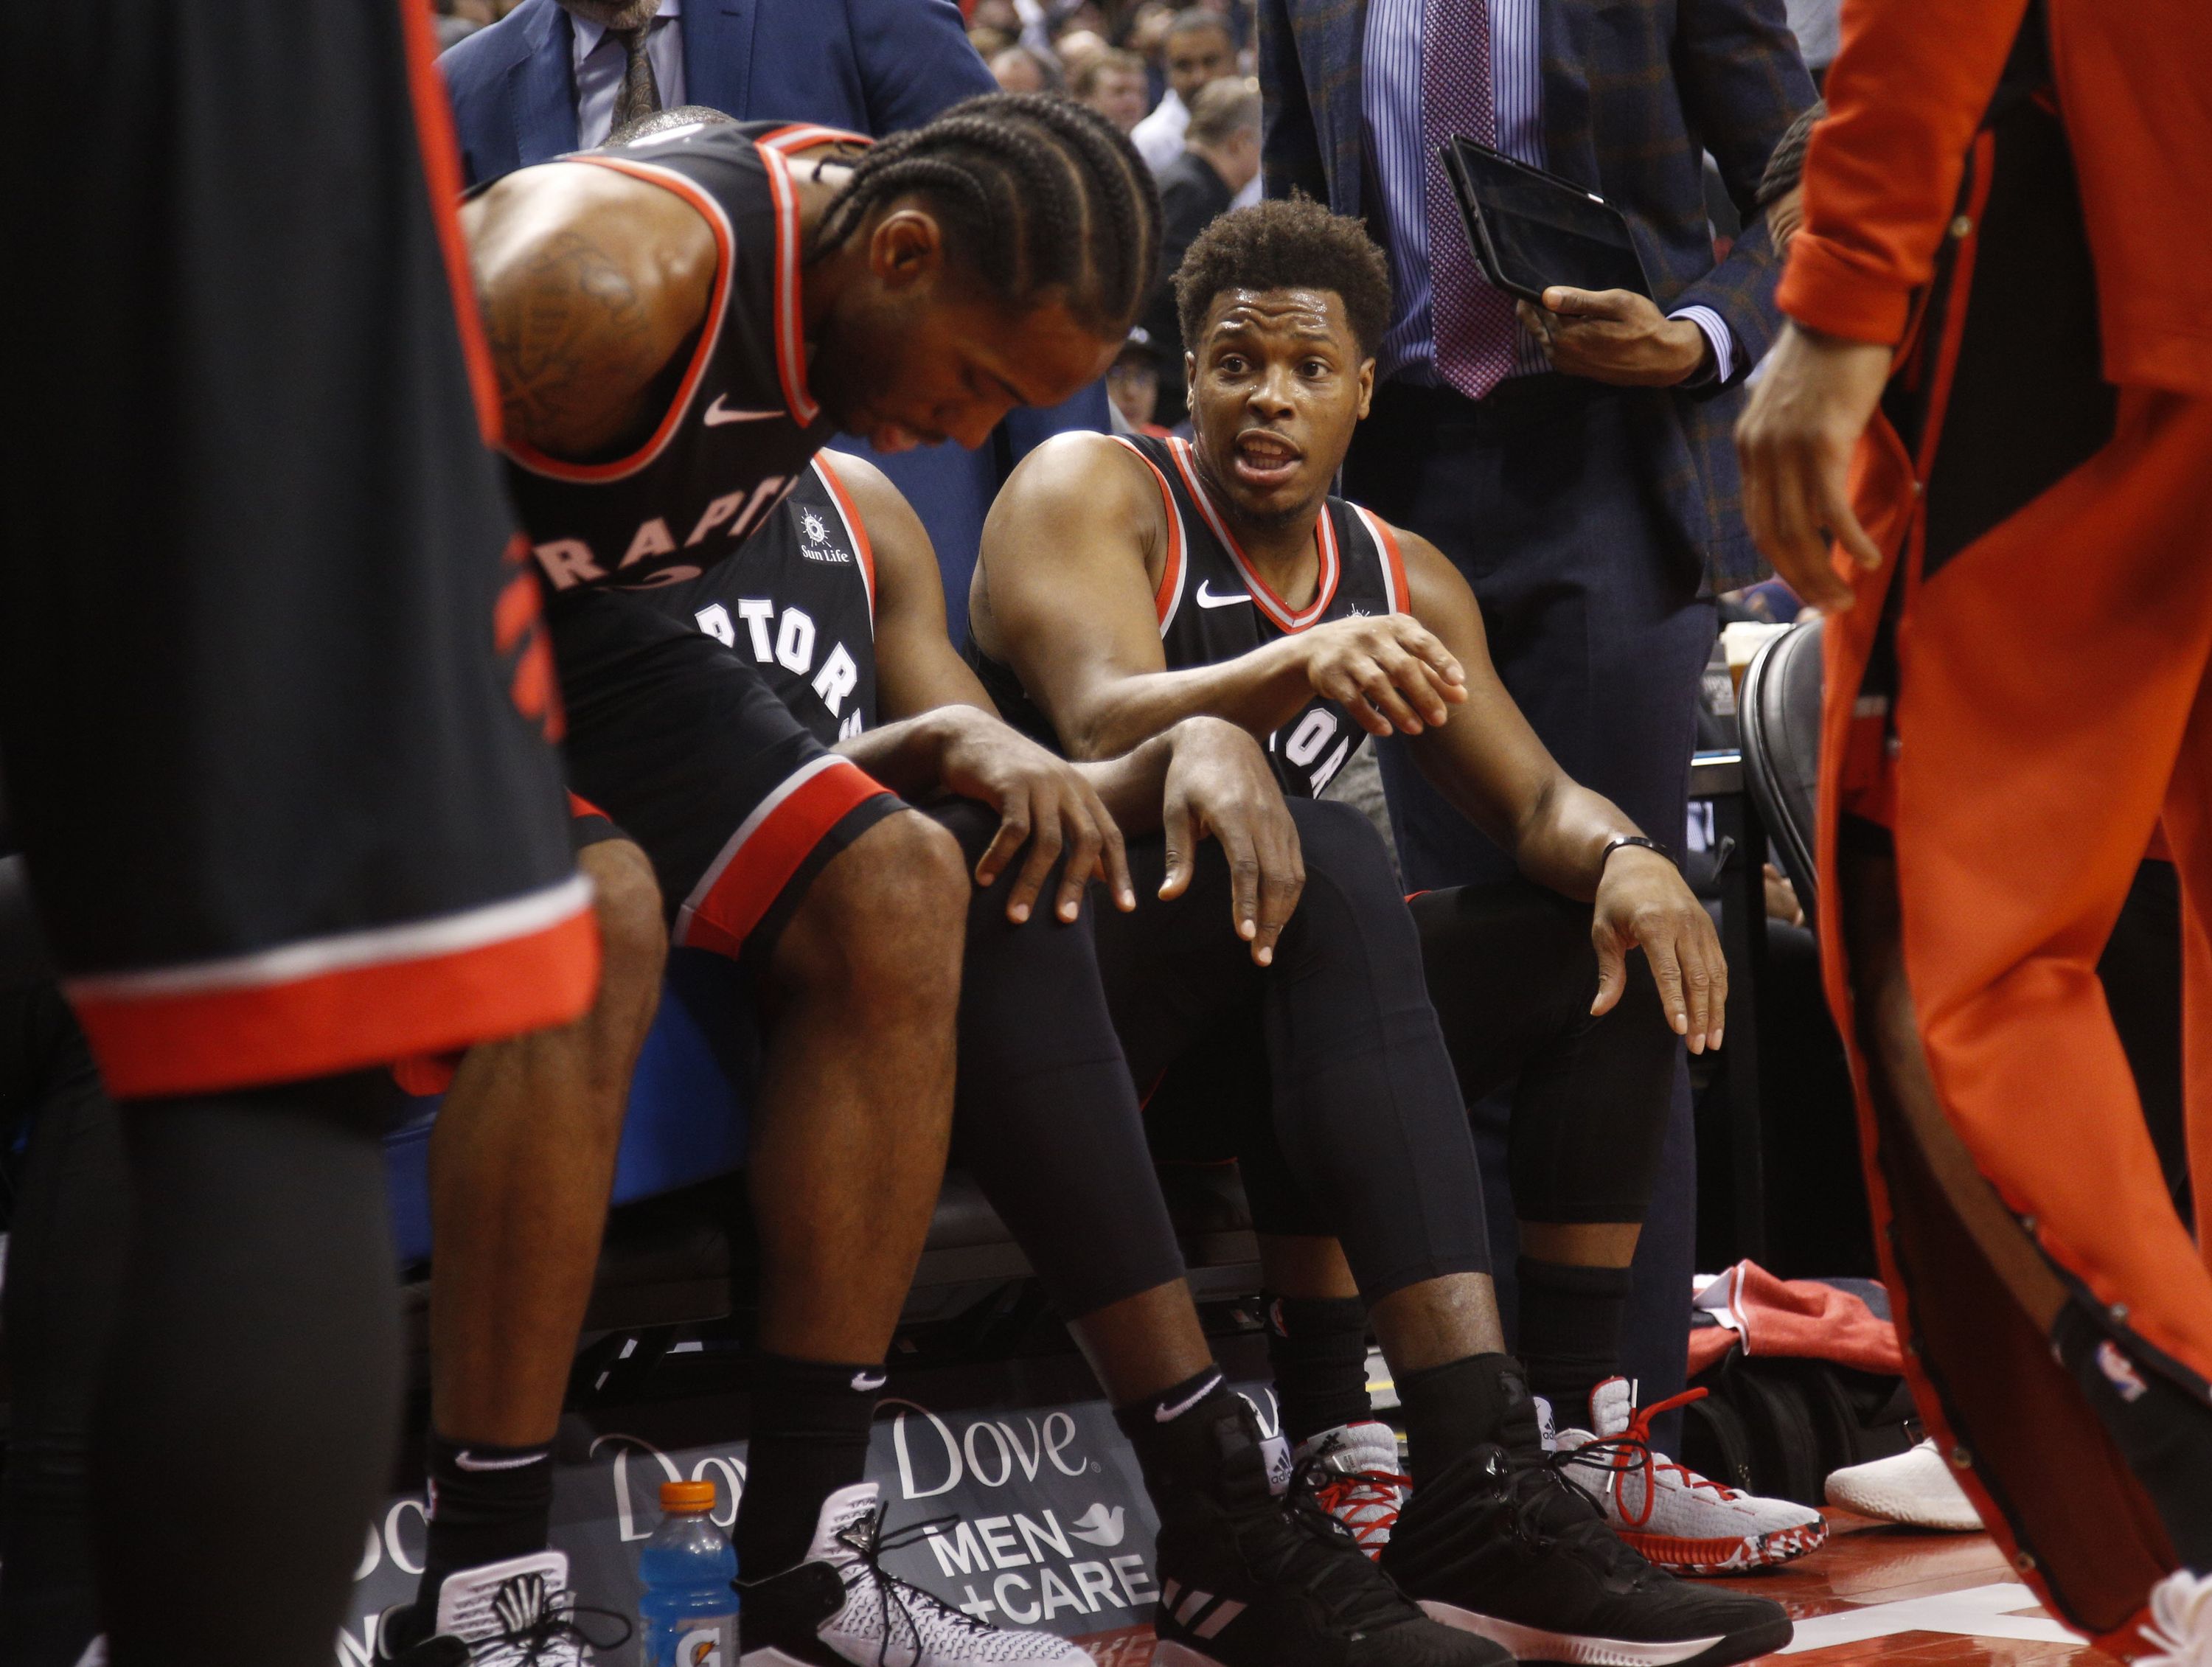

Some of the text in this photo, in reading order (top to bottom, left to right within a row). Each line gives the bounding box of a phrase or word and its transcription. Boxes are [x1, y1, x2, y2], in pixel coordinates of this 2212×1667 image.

[801, 545, 850, 563] Sun Life
[695, 598, 863, 742] PTOR
[873, 1398, 1088, 1500] Dove
[922, 1508, 1074, 1578] MEN
[959, 1553, 1161, 1625] +CARE
[675, 1627, 721, 1667] G
